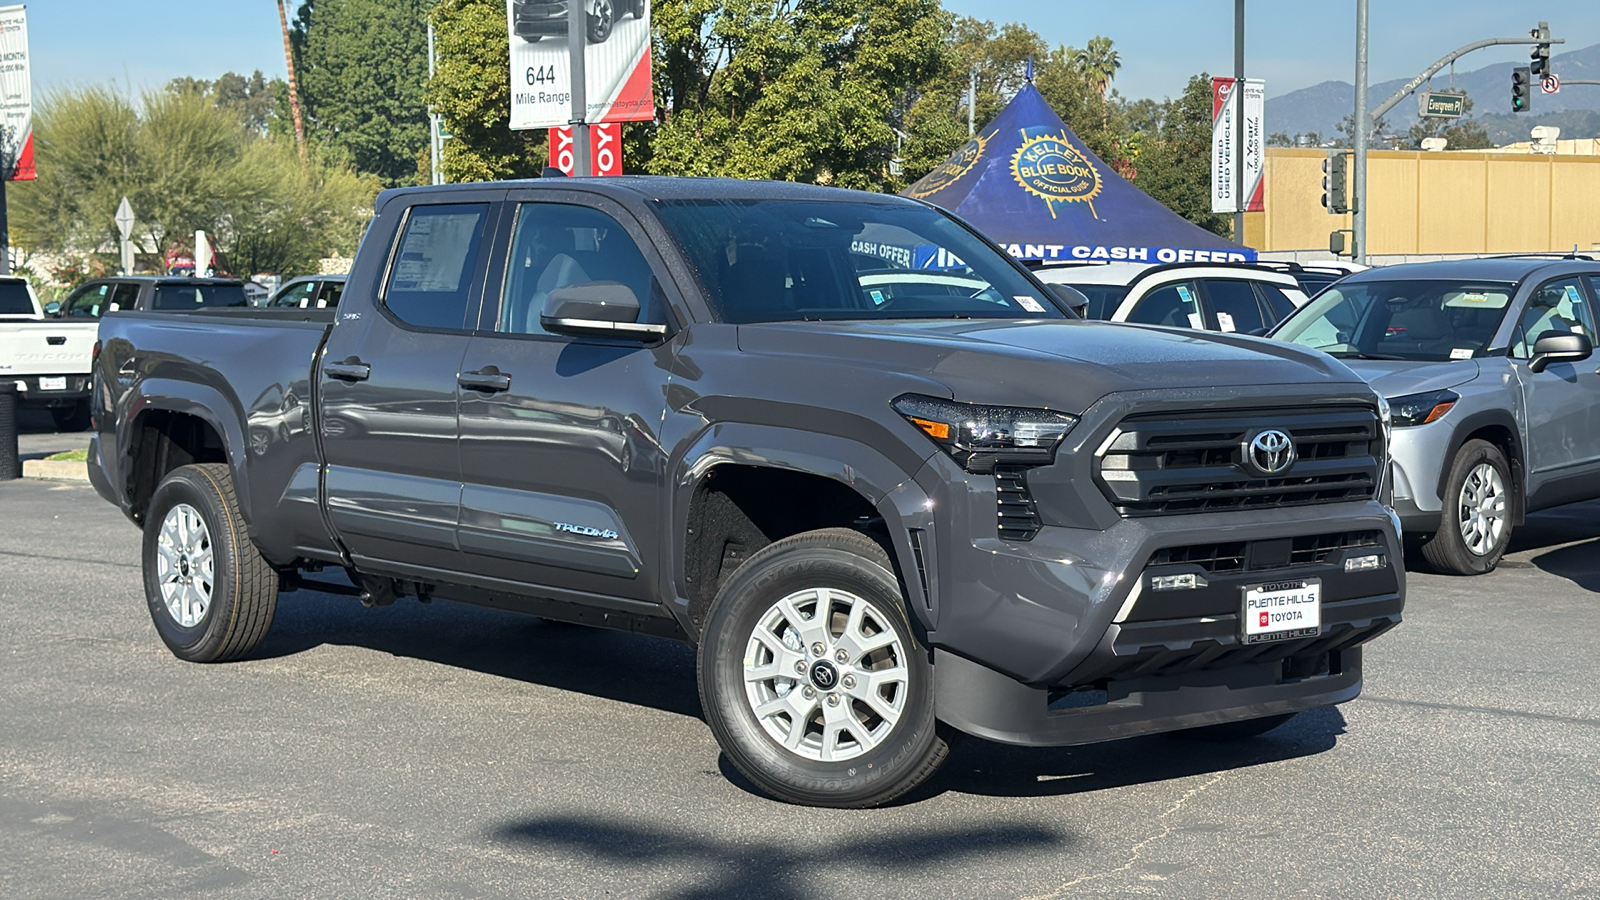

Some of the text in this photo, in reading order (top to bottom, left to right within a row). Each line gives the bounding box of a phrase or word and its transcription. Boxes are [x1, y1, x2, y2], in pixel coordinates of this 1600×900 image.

[526, 65, 555, 86] 644
[516, 92, 570, 105] Mile Range
[1429, 99, 1460, 113] Evergreen Pl
[1023, 142, 1082, 163] KELLEY
[1020, 163, 1093, 179] BLUE BOOK
[1247, 161, 1253, 170] 7
[1032, 178, 1072, 193] OFFICIAL
[851, 240, 911, 270] CASH OFFER
[1071, 246, 1148, 261] CASH
[553, 521, 618, 540] TACOMA
[1248, 593, 1315, 610] PUENTE HILLS
[1270, 611, 1303, 622] TOYOTA
[1249, 628, 1317, 643] PUENTE HILLS
